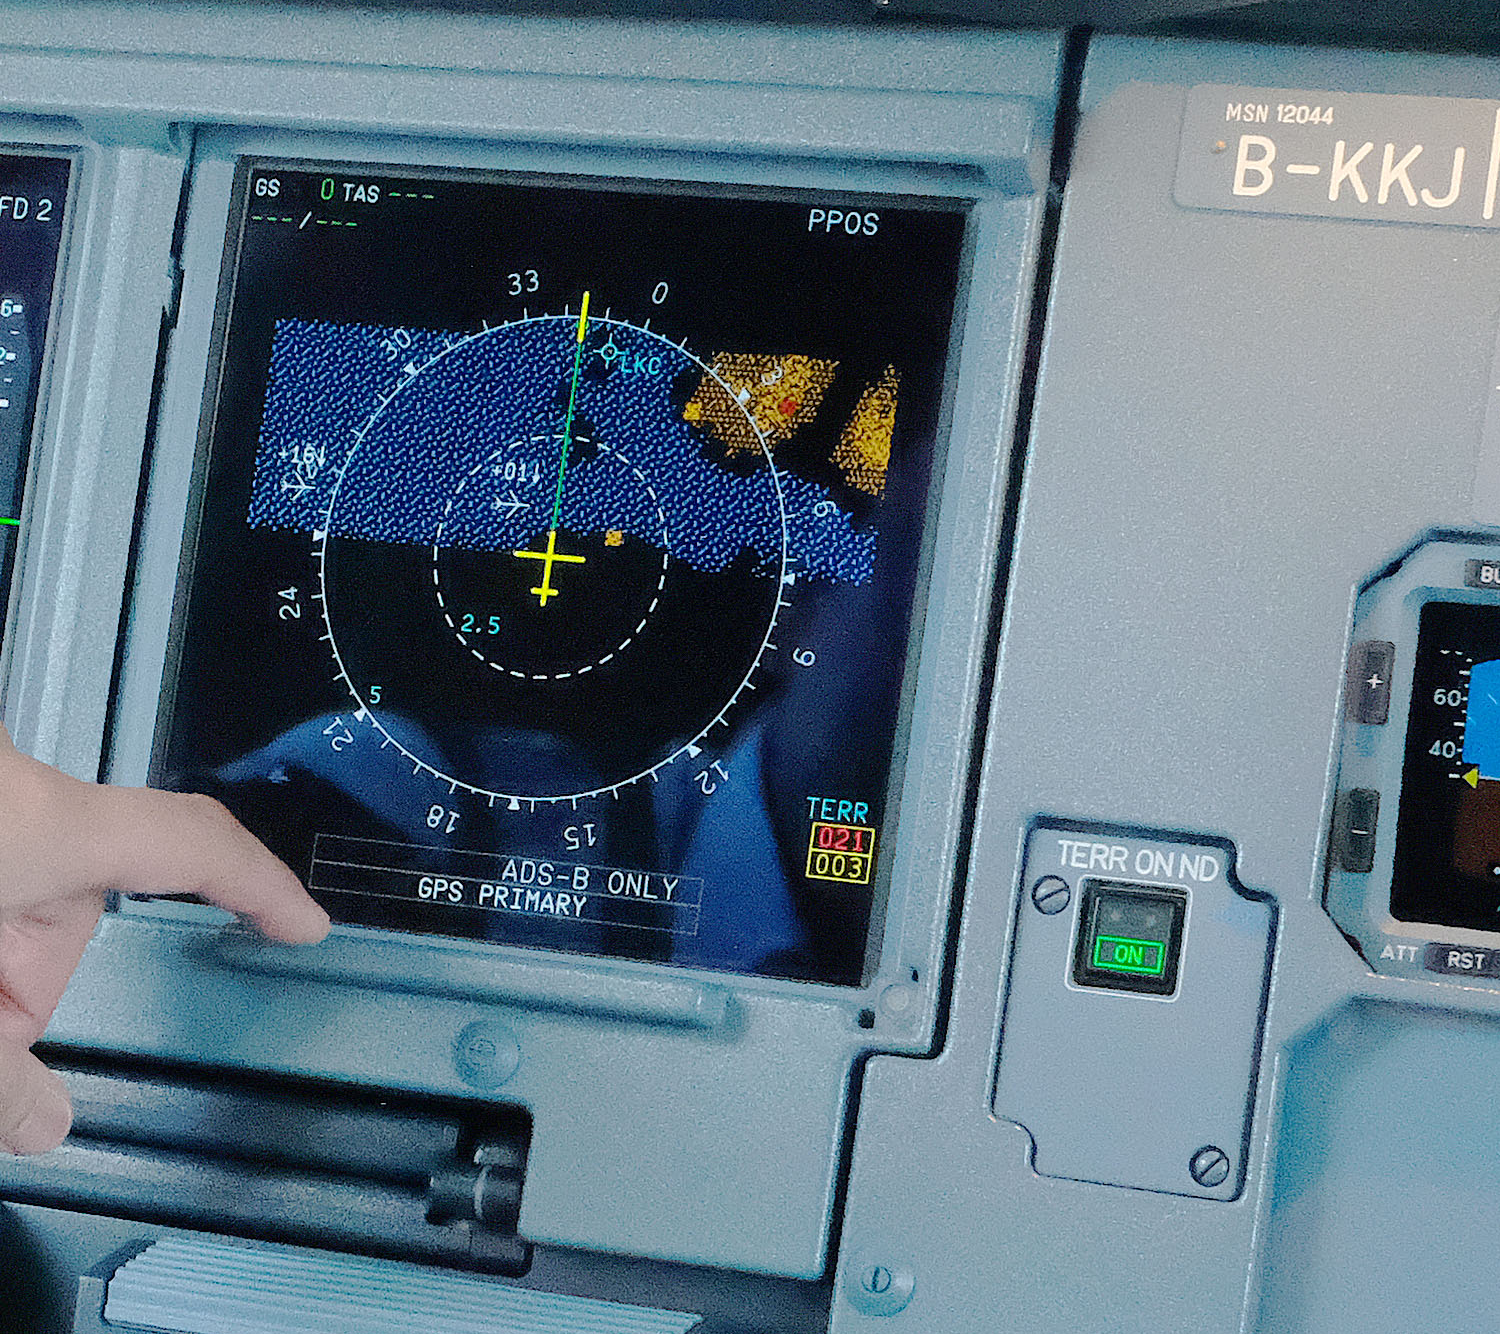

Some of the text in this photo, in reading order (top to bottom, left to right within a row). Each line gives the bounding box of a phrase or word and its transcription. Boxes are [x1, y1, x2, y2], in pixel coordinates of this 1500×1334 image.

[1226, 103, 1334, 125] MSN 12044
[1232, 134, 1465, 209] B-KKJ
[254, 178, 380, 205] GS 0 TAS
[36, 201, 52, 221] 2
[807, 210, 880, 236] PPOS
[806, 797, 869, 823] TERR
[1058, 840, 1219, 881] TERR ON ND
[502, 860, 679, 901] ADS-B ONLY
[418, 878, 588, 916] GPS PRIMARY
[1380, 944, 1485, 970] ATT RST
